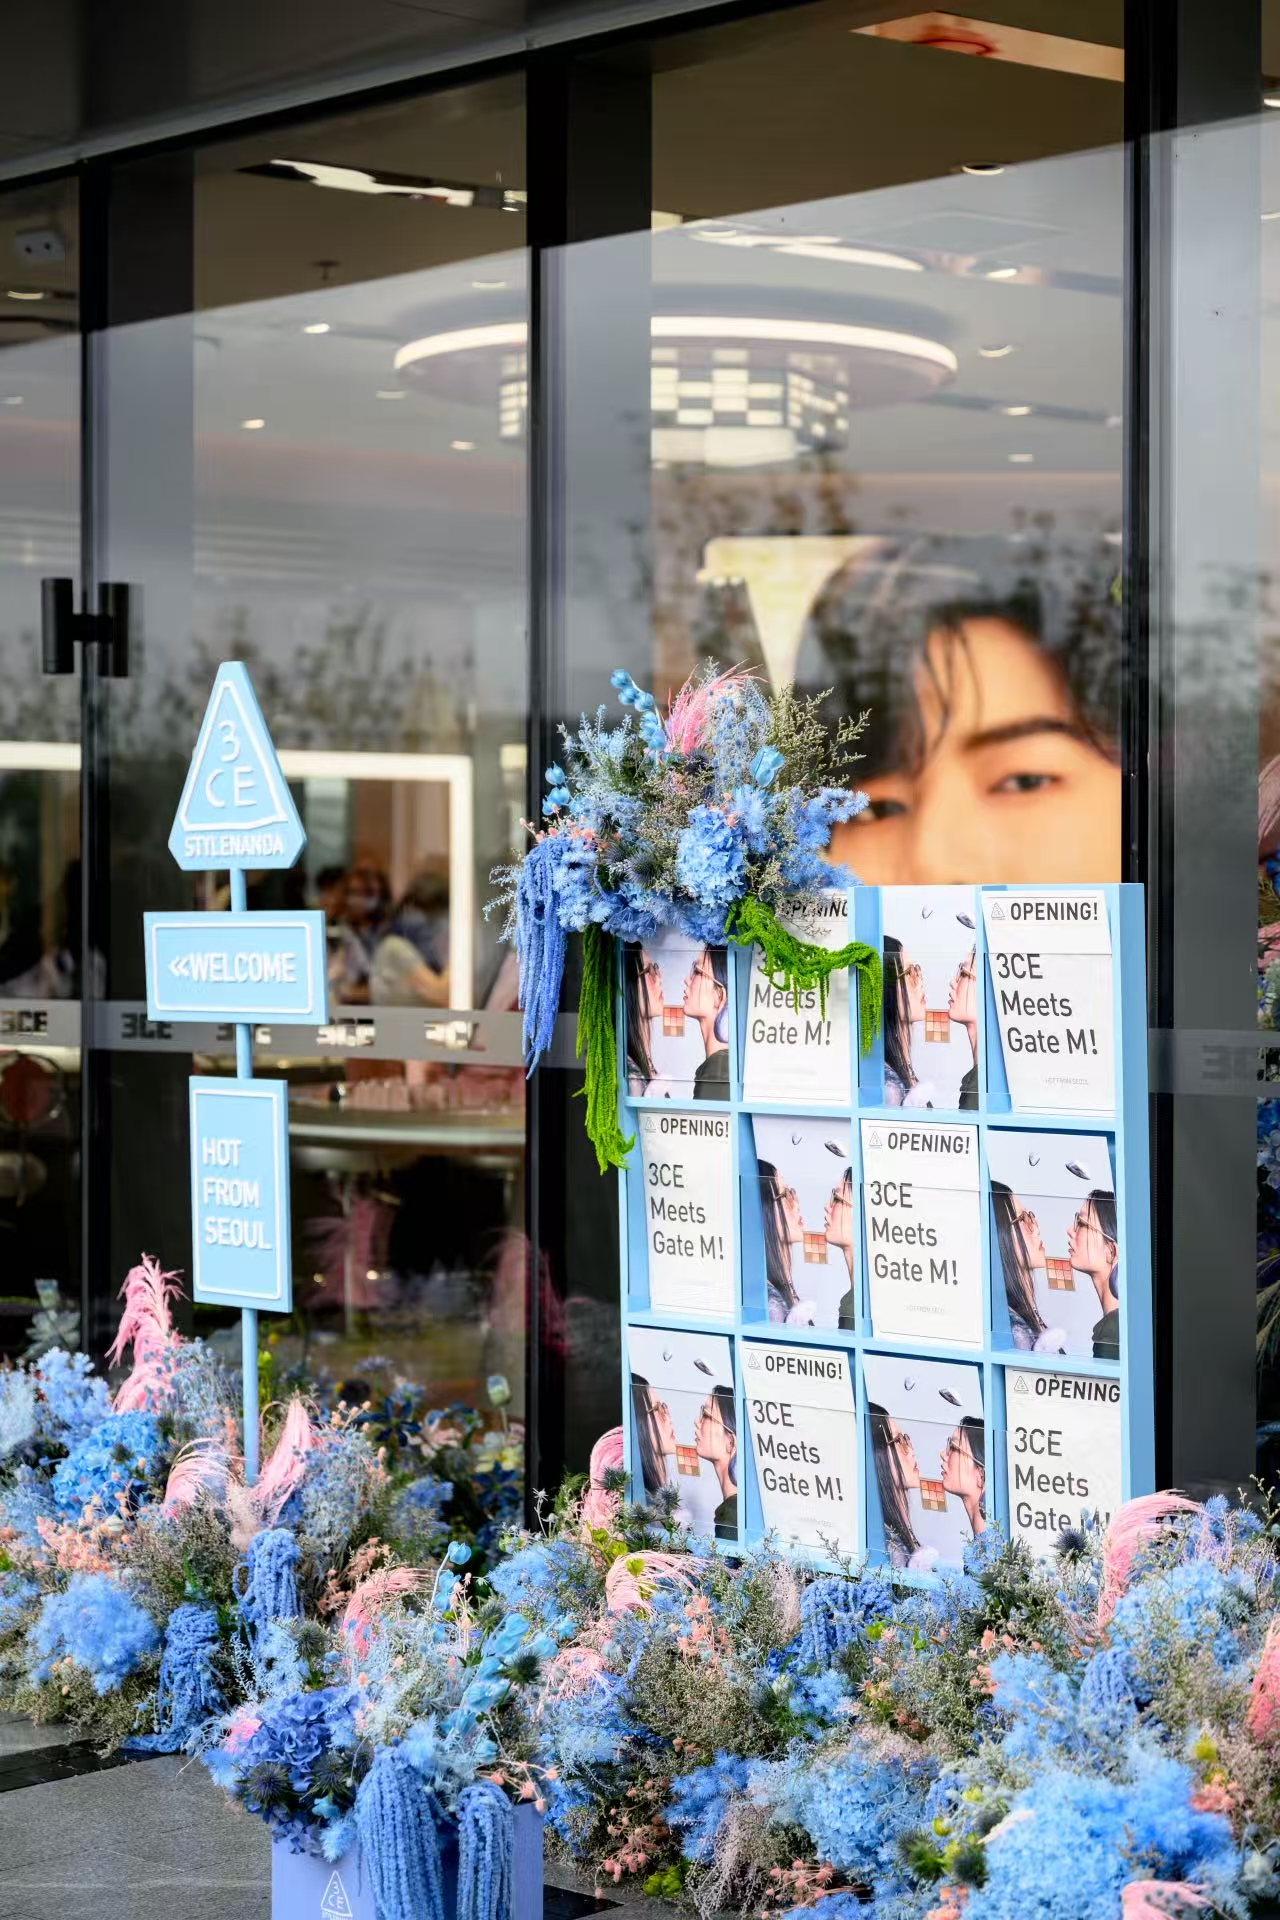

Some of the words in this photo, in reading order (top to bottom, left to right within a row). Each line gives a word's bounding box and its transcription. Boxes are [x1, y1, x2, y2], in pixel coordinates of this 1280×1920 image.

[218, 719, 240, 762] 3
[205, 765, 257, 808] CE
[184, 834, 283, 857] STYLENANDA
[1010, 902, 1099, 921] OPENING!
[996, 953, 1044, 980] 3CE
[754, 983, 816, 1009] Meets
[1001, 990, 1073, 1017] Meets
[752, 1019, 798, 1045] Gate
[804, 1020, 831, 1046] M!
[1007, 1027, 1060, 1054] Gate
[1066, 1028, 1098, 1056] M!
[660, 1117, 729, 1138] OPENING!
[202, 1138, 241, 1168] HOT
[888, 1132, 970, 1154] OPENING!
[648, 1162, 685, 1189] 3CE
[203, 1178, 261, 1209] FROM
[870, 1181, 913, 1208] 3CE
[650, 1196, 706, 1224] Meets
[204, 1217, 273, 1251] SEOUL
[653, 1230, 695, 1257] Gate
[700, 1234, 724, 1260] M!
[871, 1216, 937, 1246] Meets
[873, 1253, 924, 1281] Gate
[929, 1258, 959, 1286] M!
[765, 1355, 843, 1380] OPENING!
[1034, 1377, 1121, 1403] OPENING
[752, 1400, 795, 1427] 3CE
[756, 1433, 821, 1464] Meets
[1014, 1426, 1063, 1457] 3CE
[762, 1467, 810, 1497] Gate
[814, 1474, 844, 1501] M!
[1014, 1464, 1089, 1498] Meets
[1016, 1502, 1072, 1532] Gate
